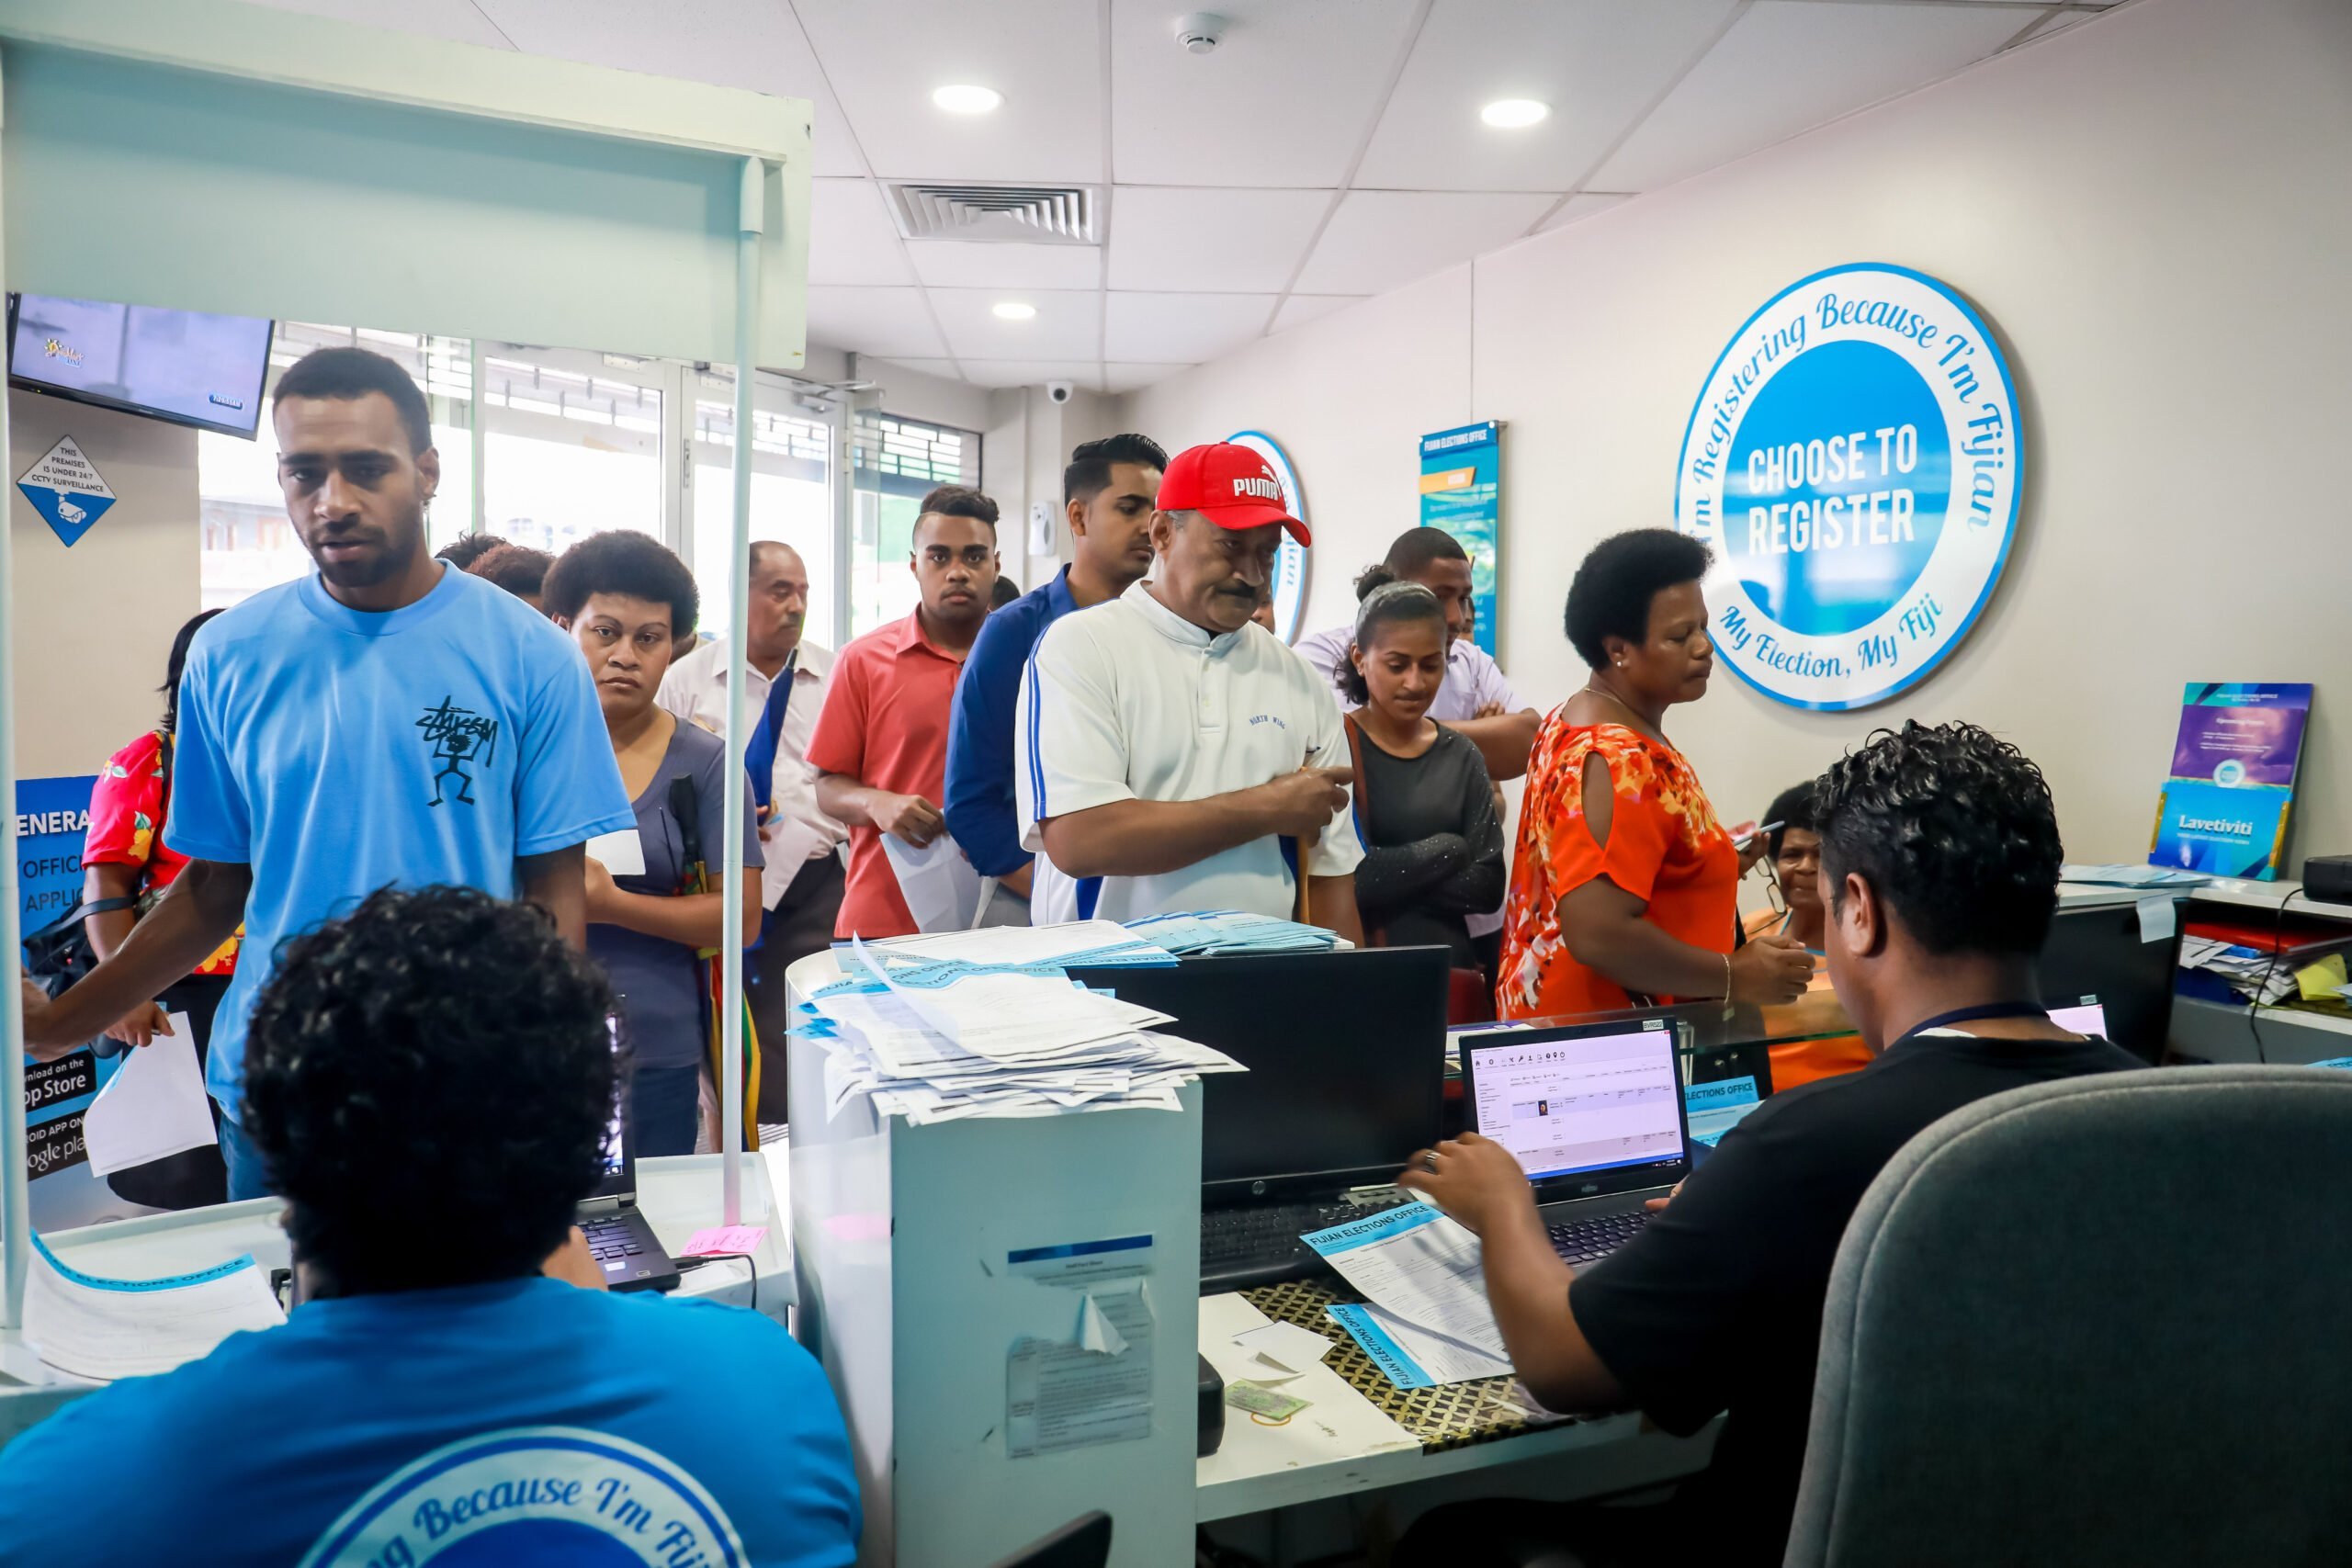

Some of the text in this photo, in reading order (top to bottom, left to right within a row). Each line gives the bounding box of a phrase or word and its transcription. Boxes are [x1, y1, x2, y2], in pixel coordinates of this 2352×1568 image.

[1693, 314, 1806, 484] Registering
[1816, 293, 1938, 348] Because
[1939, 334, 1981, 403] I'm
[1962, 402, 2004, 532] Fijian
[1469, 429, 1487, 442] OFFICE
[51, 457, 85, 468] PREMISES
[60, 447, 76, 457] THIS
[1747, 423, 1917, 495] CHOOSE TO
[31, 474, 104, 492] CCTV SURVEILLANCE
[52, 468, 77, 477] UNDER
[79, 471, 93, 479] 24/7
[1233, 478, 1279, 502] PUMA
[1749, 489, 1915, 556] REGISTER
[1720, 605, 1751, 650] My
[1858, 634, 1898, 671] My
[1899, 592, 1945, 643] Fiji
[2179, 815, 2253, 835] Lavetiviti
[55, 1064, 67, 1074] on
[69, 1058, 85, 1070] the
[44, 1074, 86, 1099] Store
[1727, 1082, 1753, 1095] OFFICE
[49, 1121, 68, 1137] APP
[1310, 1231, 1342, 1247] FIJIAN
[1345, 1214, 1396, 1238] ELECTIONS
[1395, 1204, 1430, 1221] OFFICE
[76, 1273, 176, 1287] ELECTIONS
[183, 1258, 246, 1281] OFFICE
[1333, 1305, 1358, 1328] OFFICE
[1354, 1323, 1395, 1364] ELECTIONS
[1390, 1361, 1415, 1386] FIJIAN
[413, 1478, 582, 1541] Because
[596, 1476, 653, 1534] I'm
